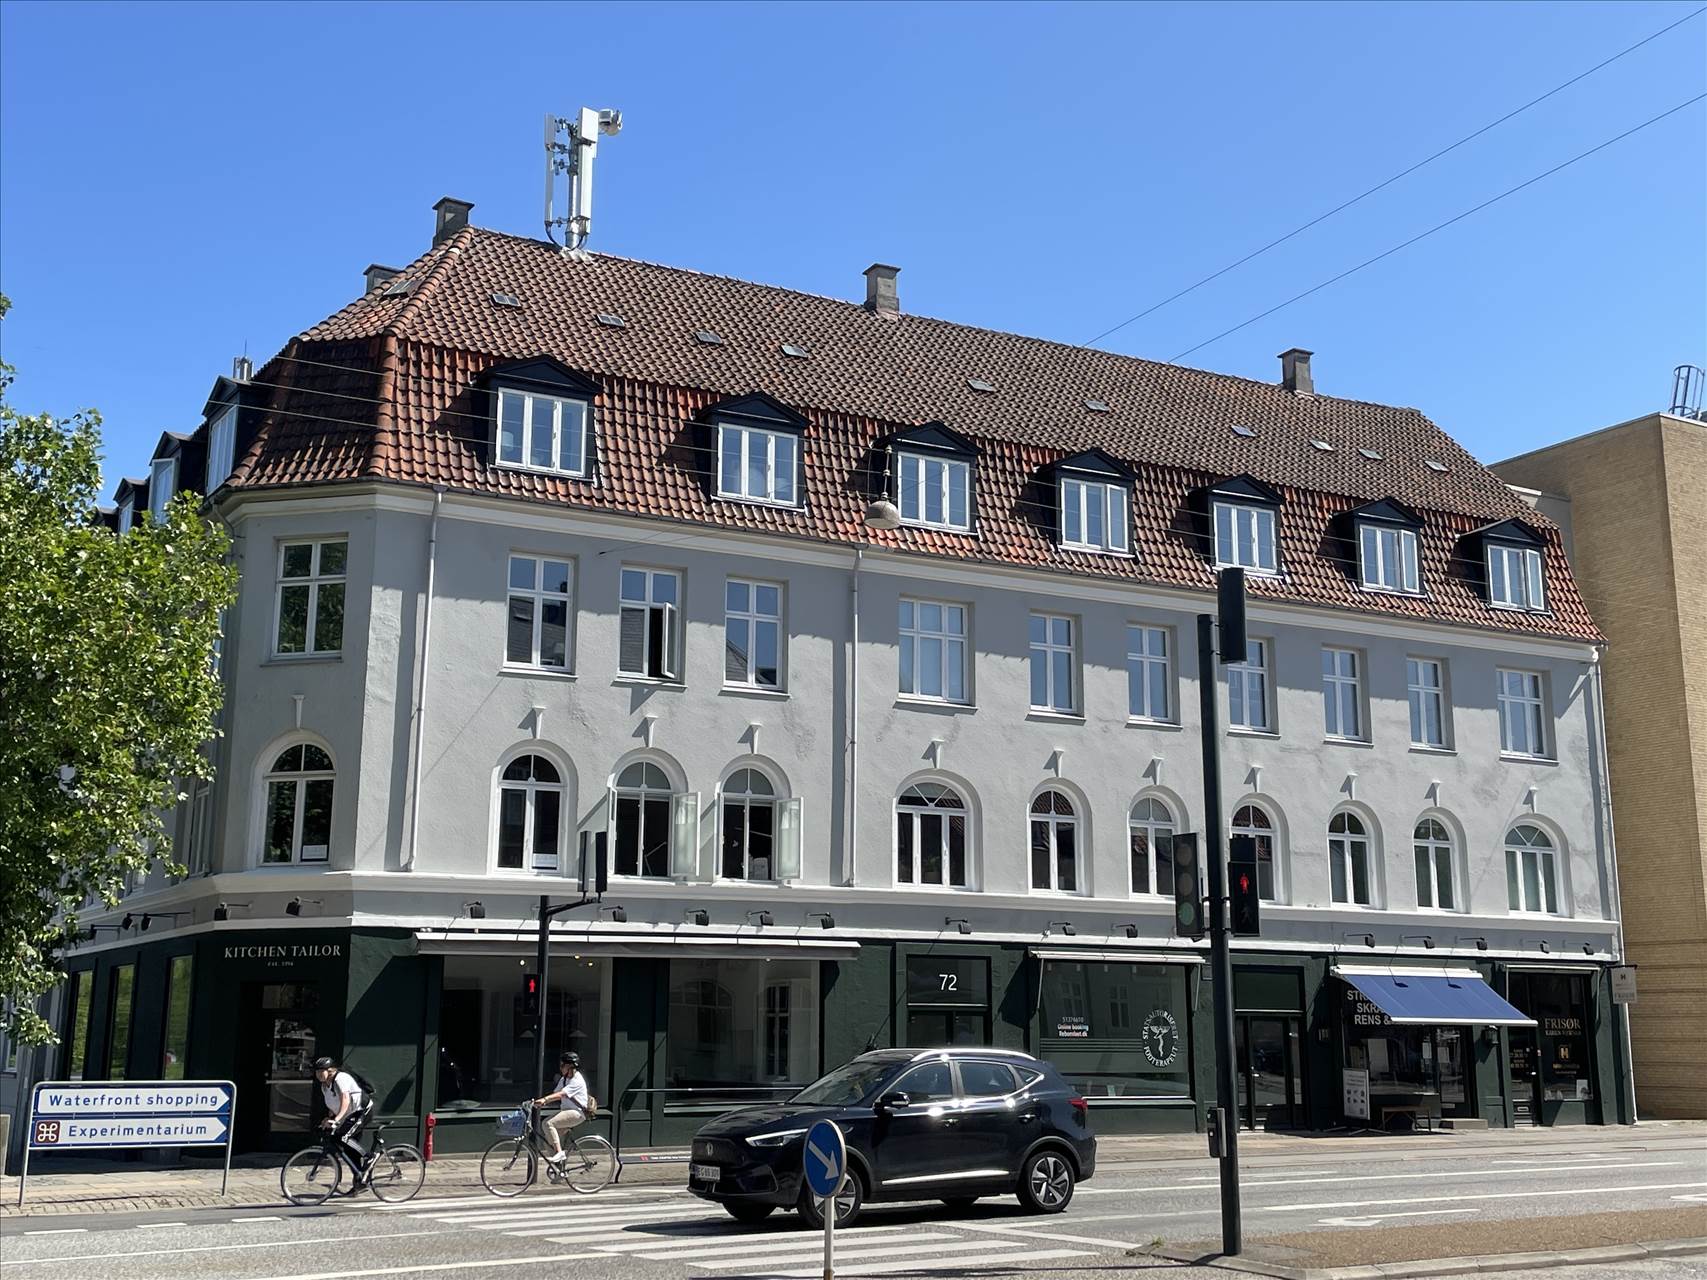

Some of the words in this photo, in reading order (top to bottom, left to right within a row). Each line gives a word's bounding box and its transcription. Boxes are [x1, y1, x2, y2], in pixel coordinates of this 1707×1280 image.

[224, 945, 287, 958] KITCHEN
[291, 944, 341, 957] TAILOR
[939, 974, 957, 990] 72
[1354, 1014, 1381, 1025] RENS
[1544, 1017, 1581, 1030] FRISØR
[1072, 1023, 1089, 1031] booking
[1143, 1045, 1178, 1067] FODTERAPEUT
[49, 1094, 141, 1107] Waterfront
[146, 1093, 219, 1107] shopping
[68, 1124, 208, 1138] Experimentarium
